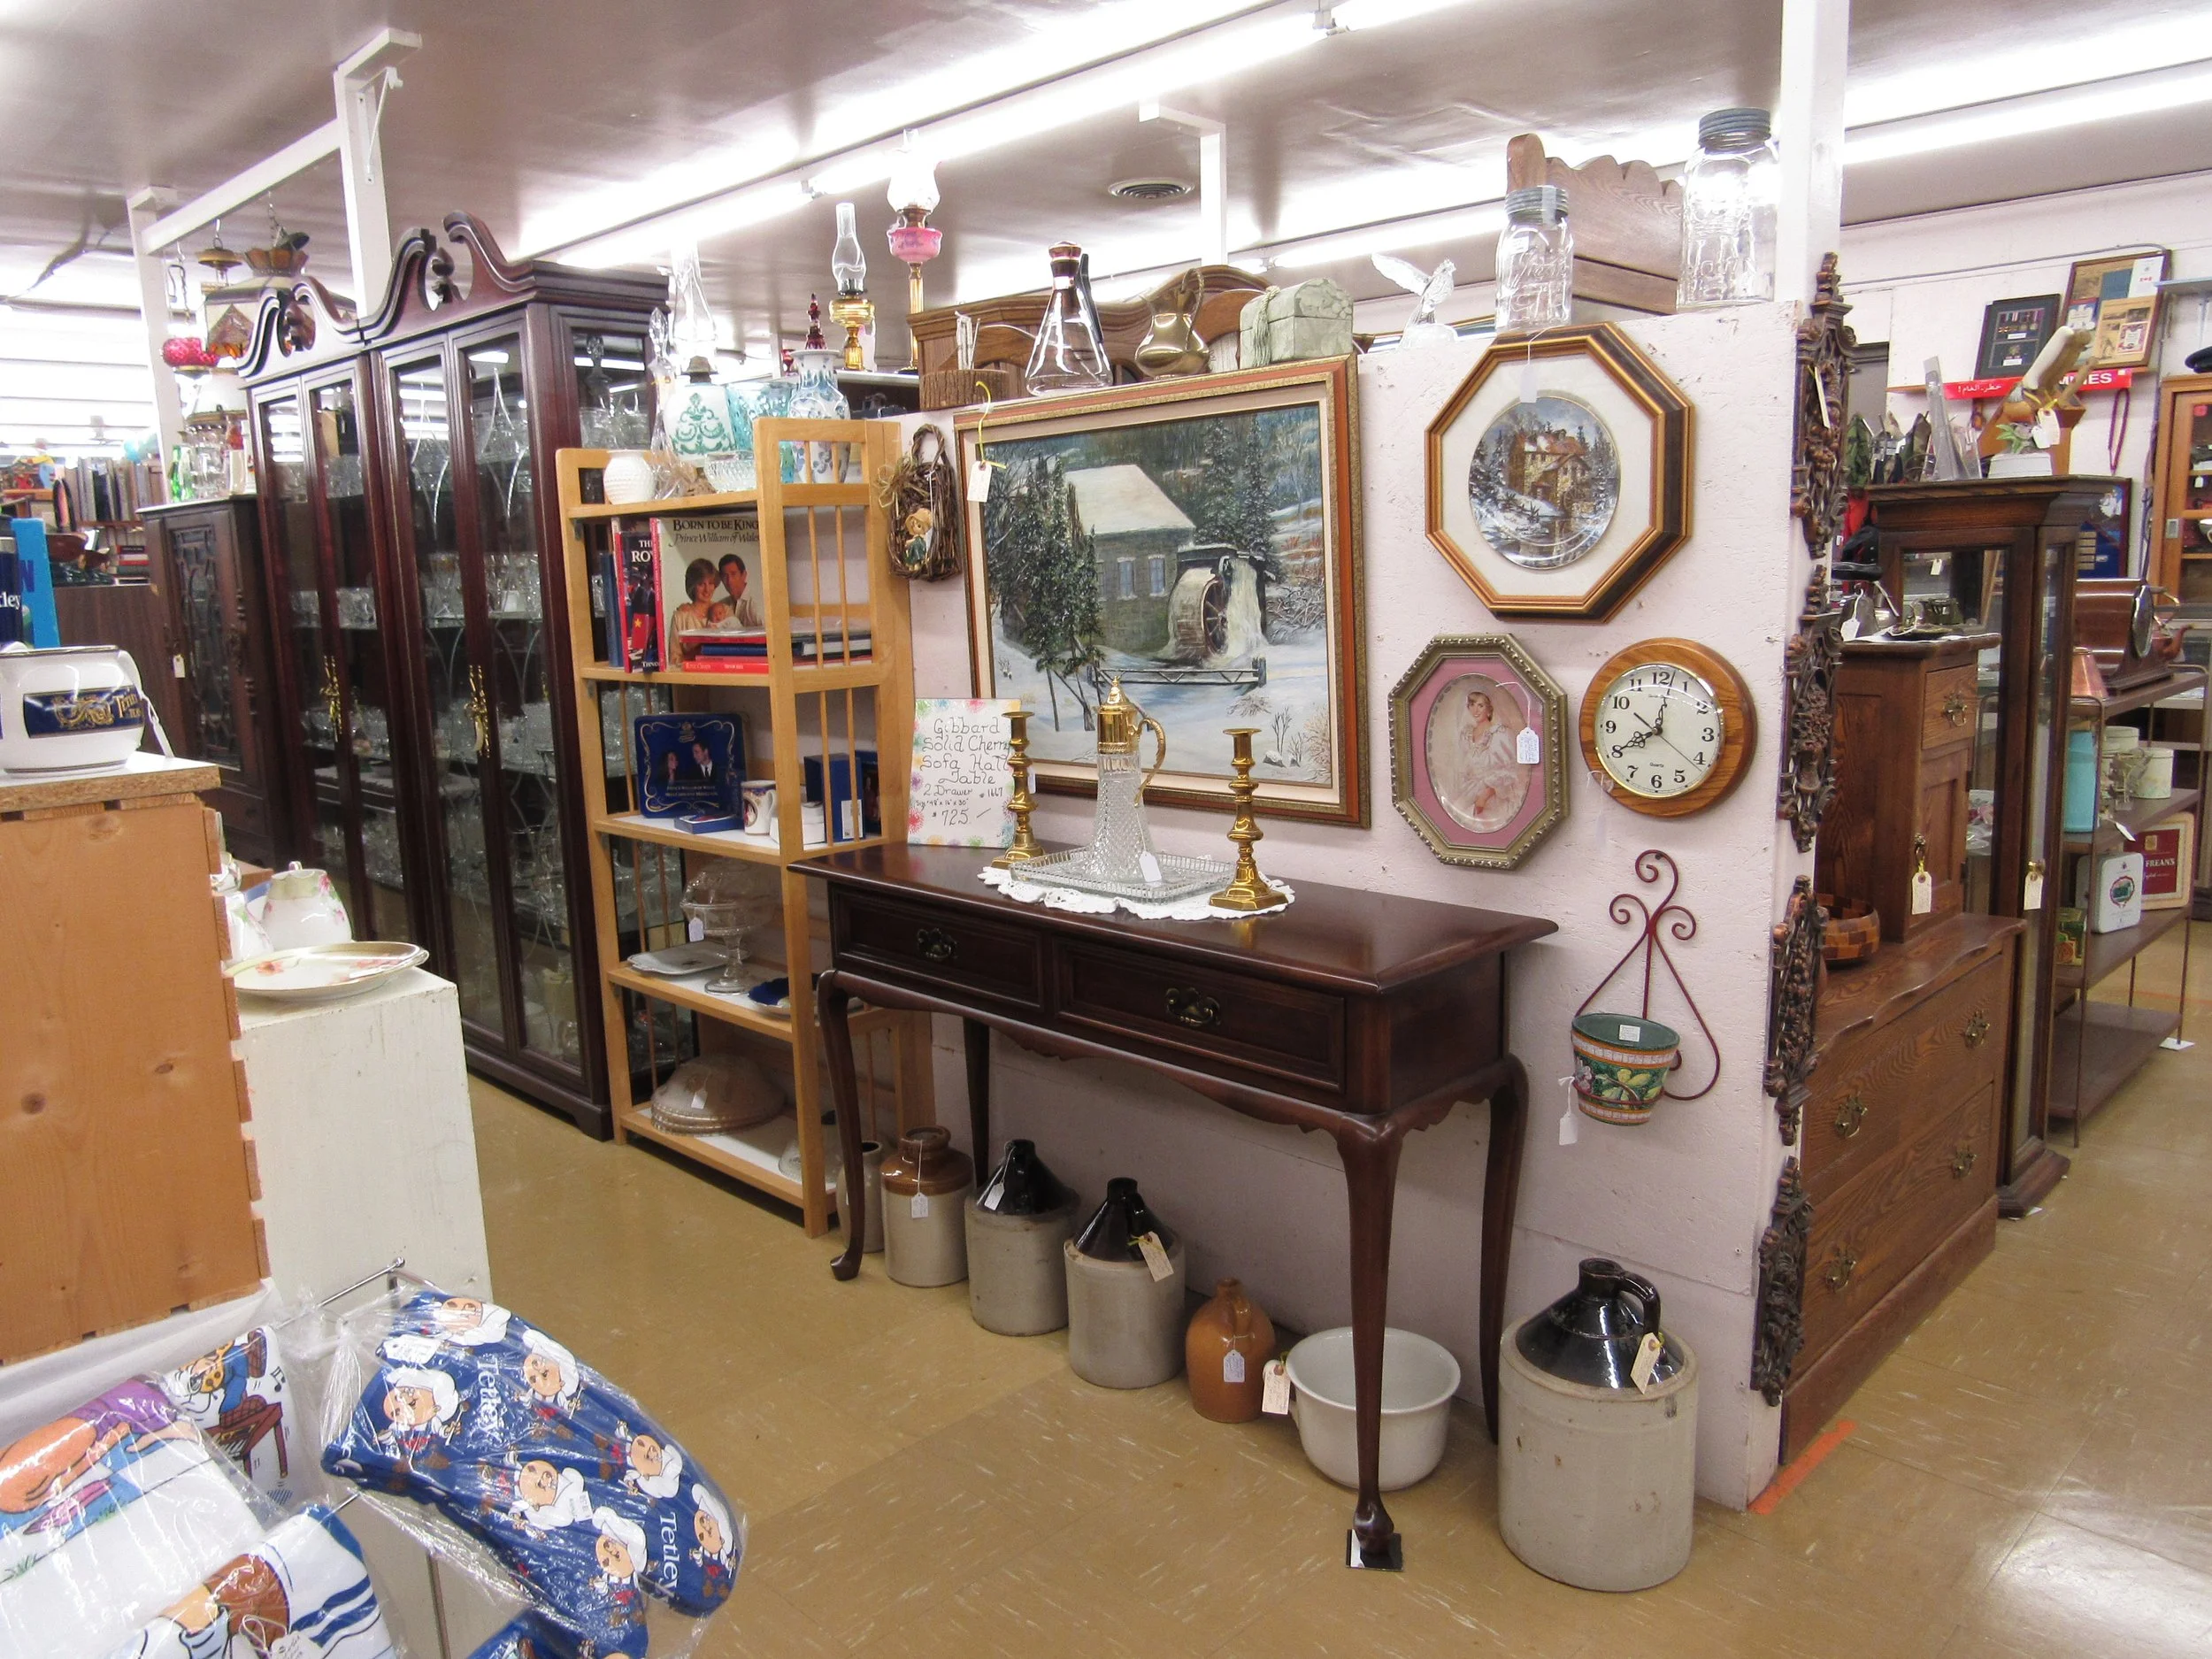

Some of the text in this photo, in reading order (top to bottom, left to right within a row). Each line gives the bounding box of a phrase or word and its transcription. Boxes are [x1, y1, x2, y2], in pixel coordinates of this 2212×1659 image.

[672, 518, 759, 531] BORN TO BE KING
[674, 532, 698, 544] Prince
[699, 531, 730, 543] William
[1629, 679, 1643, 692] 11
[1652, 672, 1671, 686] 12
[1682, 681, 1688, 692] 1
[1612, 696, 1630, 710] 10
[1696, 701, 1709, 715] 2
[933, 717, 1000, 740] Gibbard
[1606, 720, 1617, 733] 9
[1701, 727, 1715, 741] 3
[922, 734, 1010, 757] Solid Cherry
[1611, 745, 1623, 758] 8
[920, 753, 1010, 772] Sofa Hall
[1694, 752, 1706, 765] 4
[938, 768, 996, 785] Table
[1627, 765, 1639, 779] 7
[1674, 770, 1686, 783] 5
[1651, 775, 1663, 788] 6
[924, 783, 932, 795] 2
[933, 784, 973, 795] Drawer
[658, 1511, 680, 1599] Tetley
